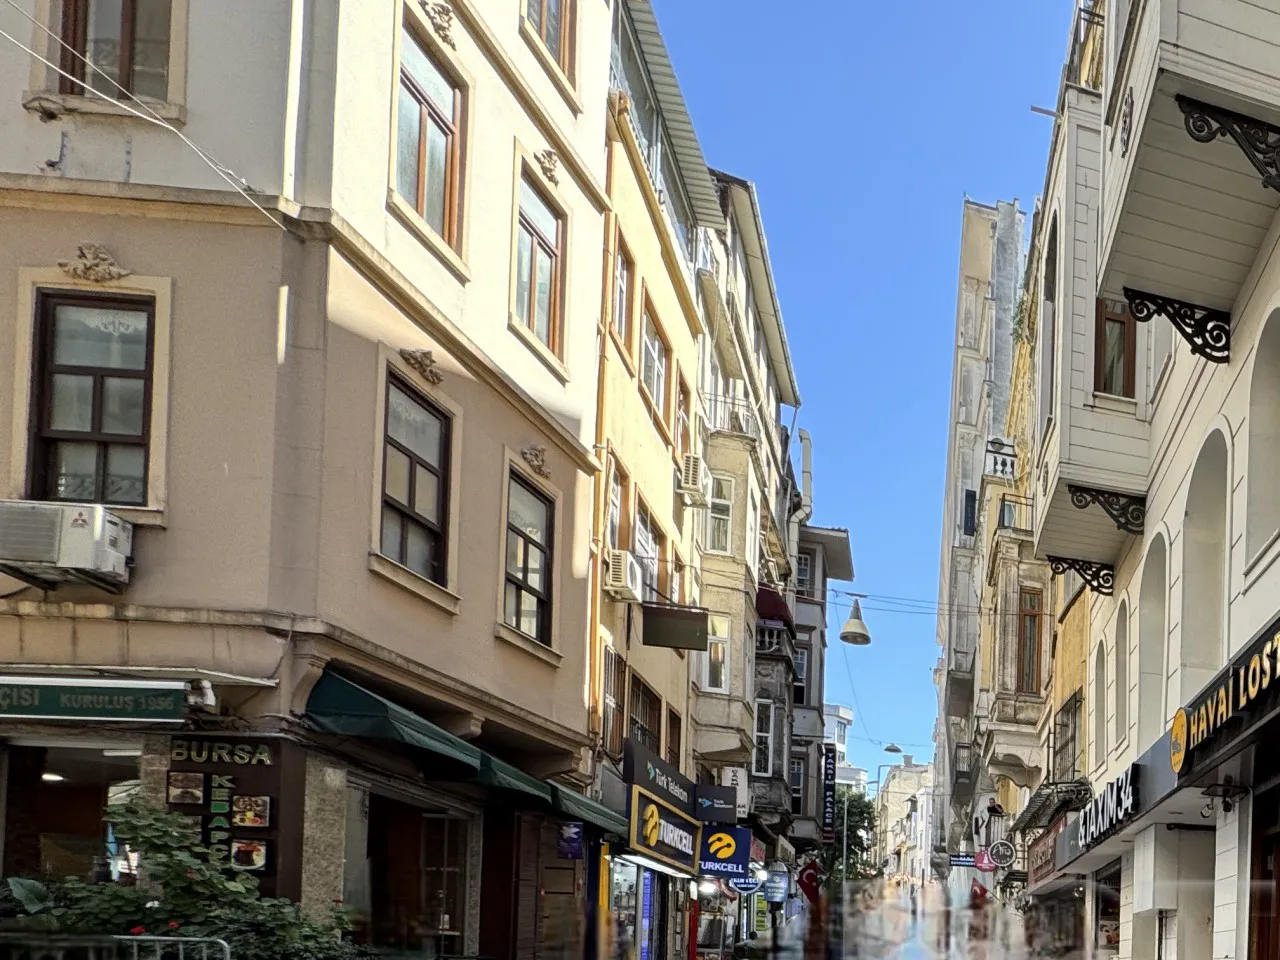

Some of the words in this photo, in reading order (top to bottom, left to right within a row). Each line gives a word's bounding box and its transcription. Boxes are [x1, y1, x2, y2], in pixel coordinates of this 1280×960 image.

[171, 740, 274, 766] BURSA
[655, 768, 668, 790] Türk
[667, 776, 688, 803] Telekom
[1117, 763, 1133, 819] 34
[824, 791, 834, 823] PALACE
[658, 818, 694, 856] TURKCELL
